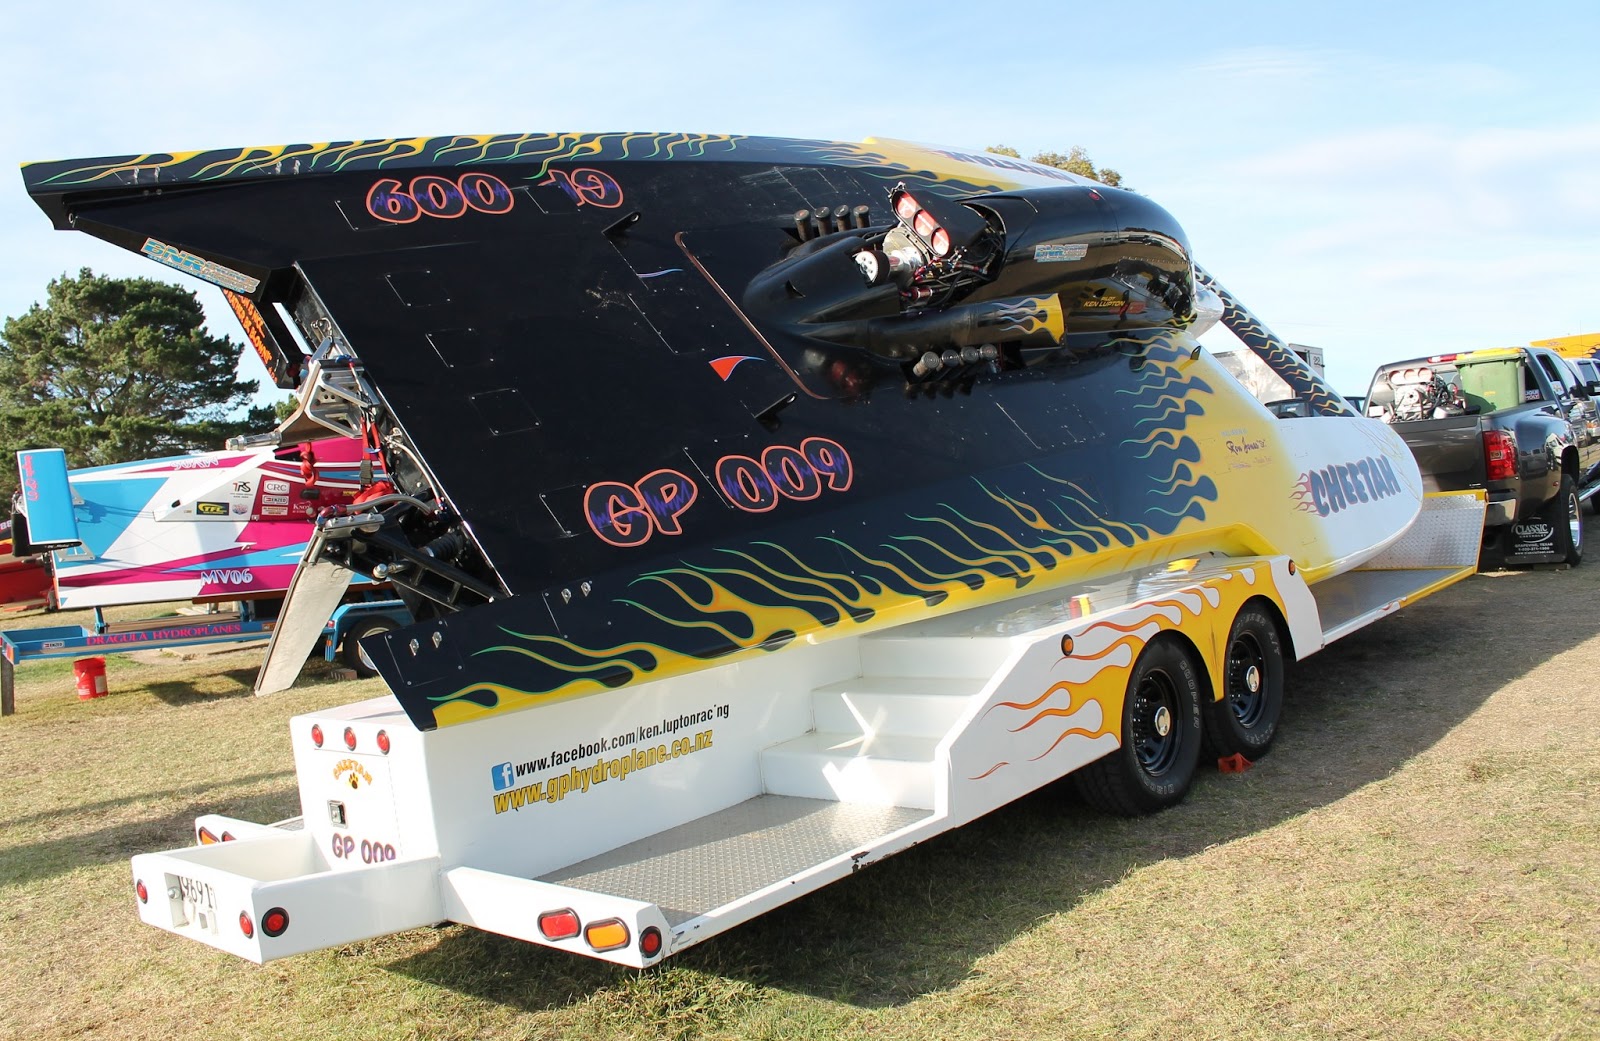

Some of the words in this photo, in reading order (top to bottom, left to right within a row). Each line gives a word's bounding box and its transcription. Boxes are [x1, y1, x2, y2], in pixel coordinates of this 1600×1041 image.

[366, 172, 515, 225] 009
[266, 483, 287, 491] CRC
[584, 468, 699, 547] GP
[715, 436, 853, 513] 009
[1309, 454, 1402, 518] CHEETAH
[1515, 523, 1548, 535] CLASSIC
[200, 568, 253, 585] MV06
[86, 632, 148, 646] DRAGULA
[152, 624, 241, 640] HYDROPLANES
[515, 703, 730, 777] www.facebook.com/ken.luptonracng
[493, 729, 714, 814] www.gphydroplane.co.nz
[332, 832, 356, 860] GP
